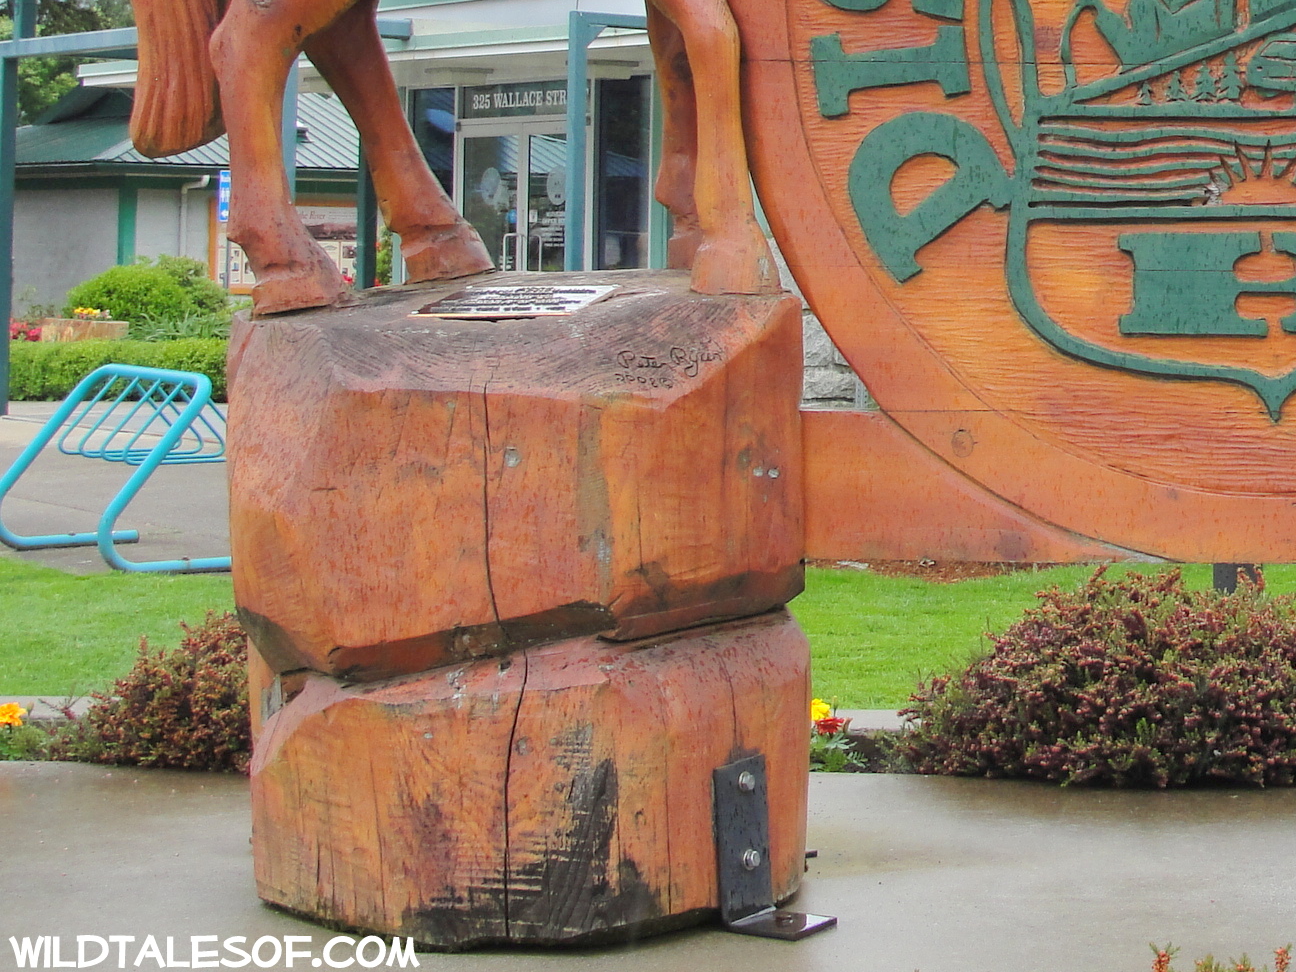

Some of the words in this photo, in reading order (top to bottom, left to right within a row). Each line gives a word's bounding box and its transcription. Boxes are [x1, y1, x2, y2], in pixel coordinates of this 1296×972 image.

[473, 94, 490, 109] 325
[493, 91, 543, 108] WALLACE
[617, 350, 674, 369] Peter
